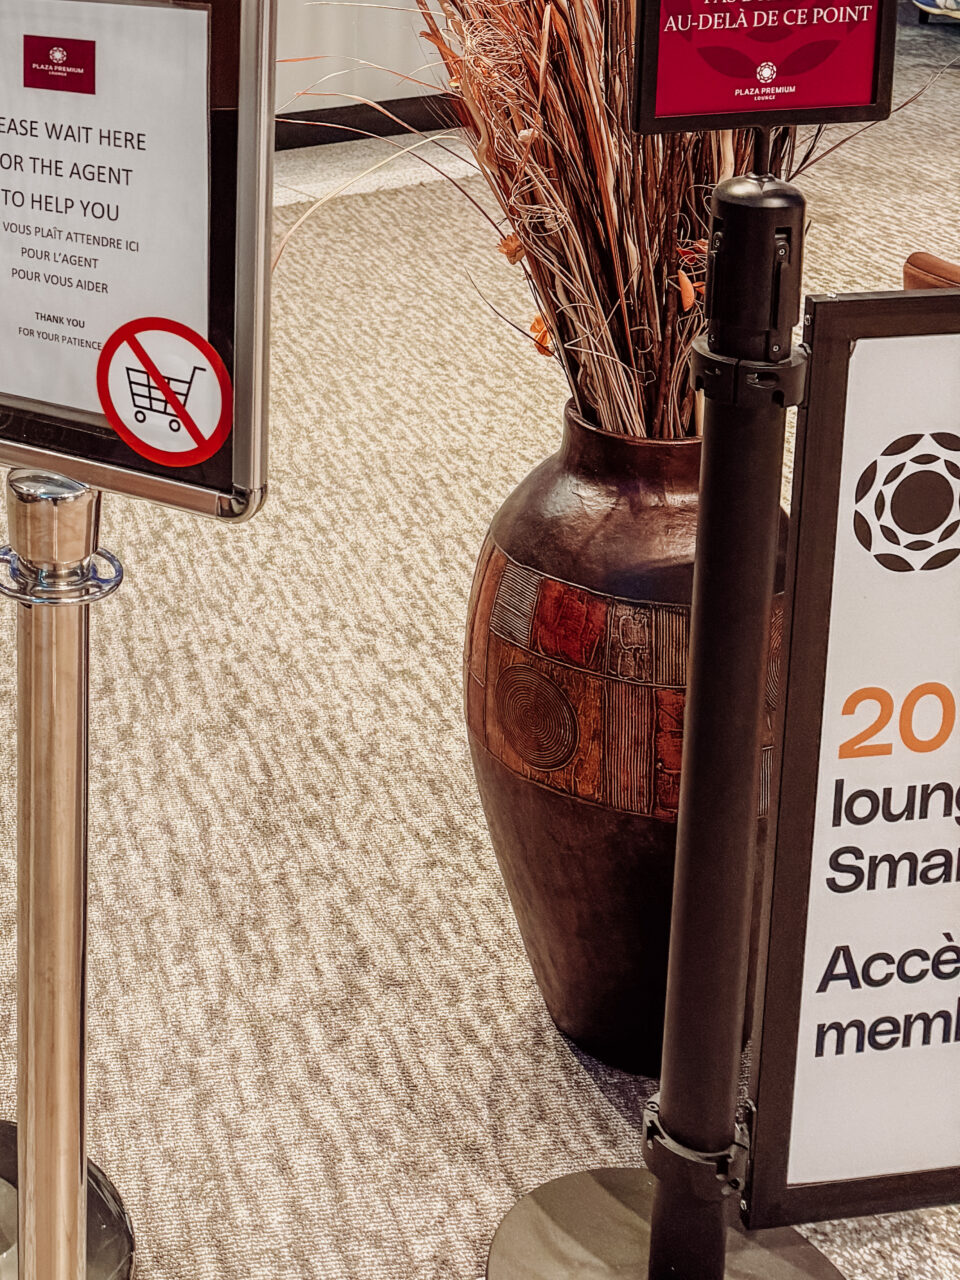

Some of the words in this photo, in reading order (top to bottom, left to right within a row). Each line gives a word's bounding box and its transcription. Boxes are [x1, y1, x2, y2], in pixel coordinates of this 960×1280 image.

[663, 9, 748, 32] AU-DELÀ
[753, 10, 779, 28] DE
[783, 8, 808, 25] CE
[813, 5, 872, 24] POINT
[32, 63, 53, 71] PLAZA
[54, 65, 84, 73] PREMIUM
[734, 88, 759, 96] PLAZA
[761, 86, 796, 95] PREMIUM
[44, 122, 93, 144] WAIT
[99, 129, 146, 151] HERE
[29, 156, 64, 178] THE
[69, 162, 133, 186] AGENT
[1, 188, 25, 207] TO
[31, 193, 74, 214] HELP
[80, 200, 119, 221] YOU
[3, 221, 32, 236] VOUS
[34, 226, 63, 240] PLAÎT
[66, 231, 122, 250] ATTENDRE
[125, 240, 139, 252] ICI
[21, 247, 50, 261] POUR
[53, 252, 99, 269] L'AGENT
[11, 267, 40, 282] POUR
[43, 273, 73, 288] VOUS
[76, 279, 109, 294] AIDER
[34, 312, 64, 325] THANK
[66, 318, 85, 328] YOU
[18, 327, 35, 337] FOR
[36, 330, 60, 343] YOUR
[837, 681, 957, 760] 20
[832, 777, 960, 830] loun
[825, 845, 960, 895] Sma
[814, 995, 960, 1058] mem
